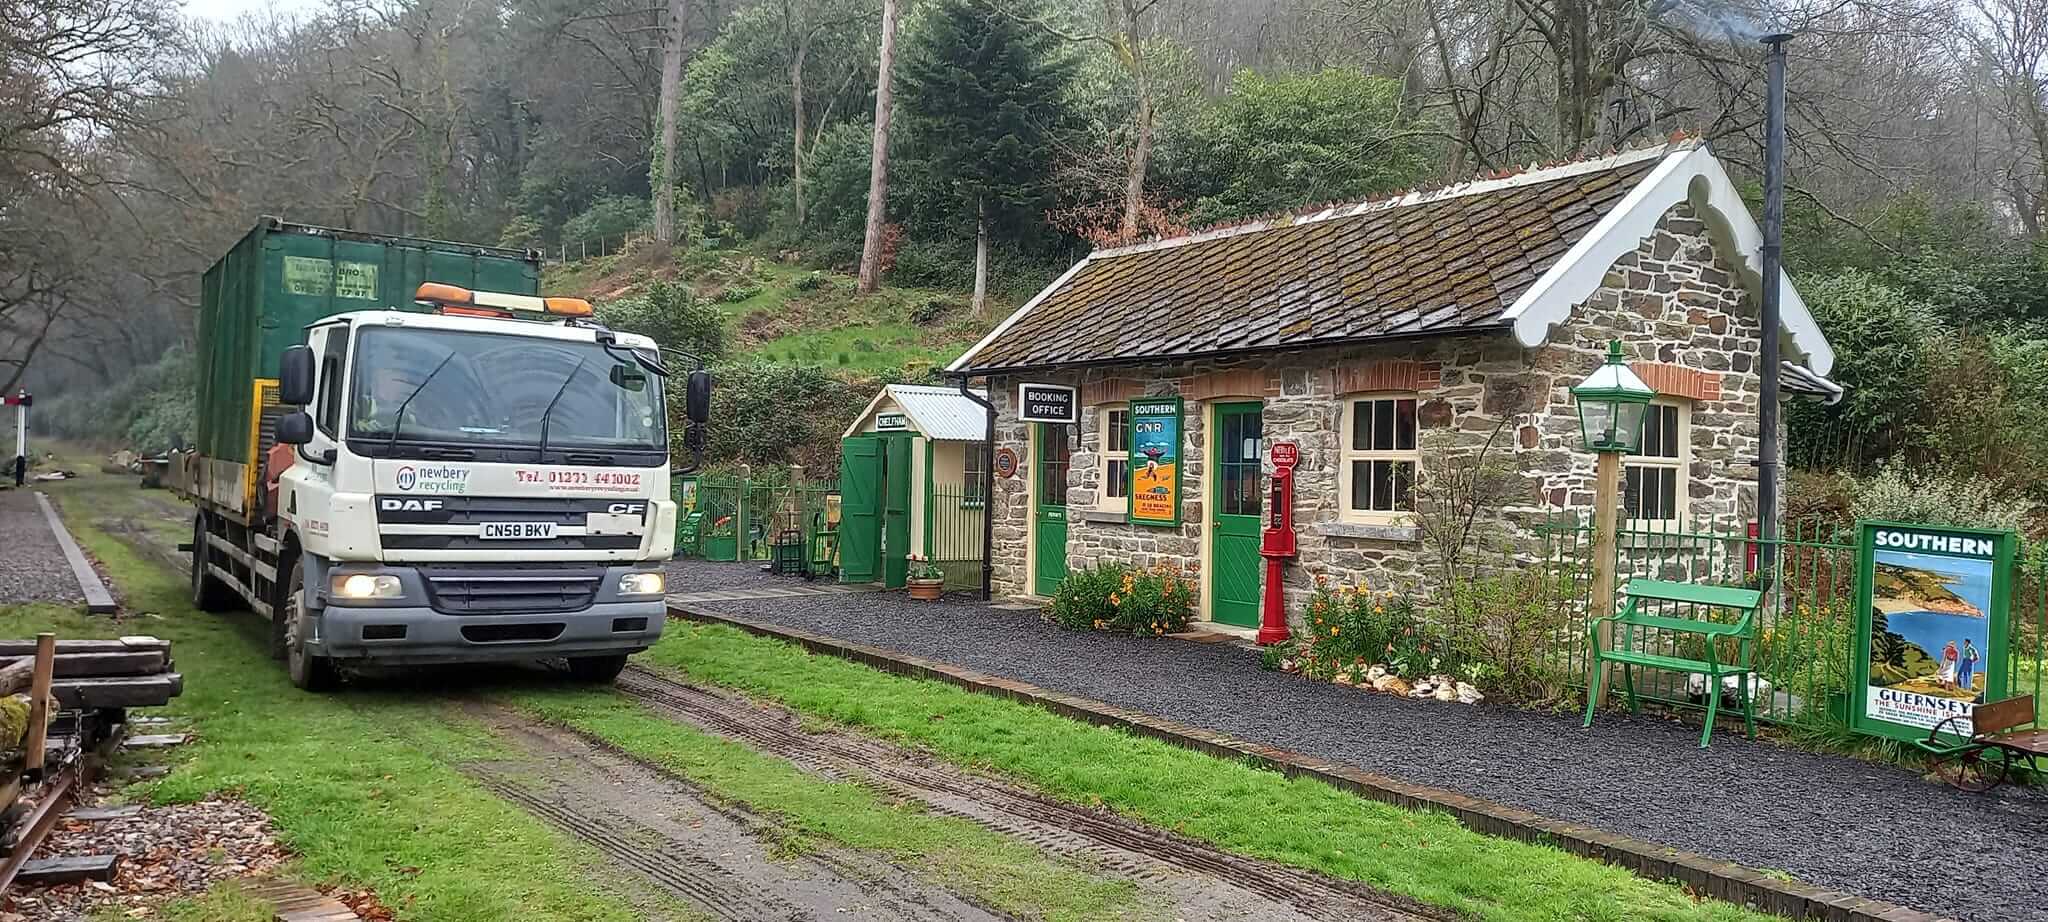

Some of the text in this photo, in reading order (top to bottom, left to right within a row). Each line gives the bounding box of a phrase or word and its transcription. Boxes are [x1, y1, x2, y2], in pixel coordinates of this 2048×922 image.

[1028, 391, 1068, 403] BOOKING
[1032, 404, 1064, 416] OFFICE
[1134, 404, 1176, 415] SOUTHERN
[419, 465, 470, 480] newbery
[419, 480, 465, 494] recycling
[381, 499, 443, 511] DAF
[607, 503, 644, 514] CF
[486, 524, 551, 537] CN58 BKV
[1875, 530, 1994, 556] SOUTHERN
[1873, 698, 1890, 707] THE
[1894, 702, 1937, 716] SUNSHINE
[1879, 688, 1971, 714] GUERNSEY
